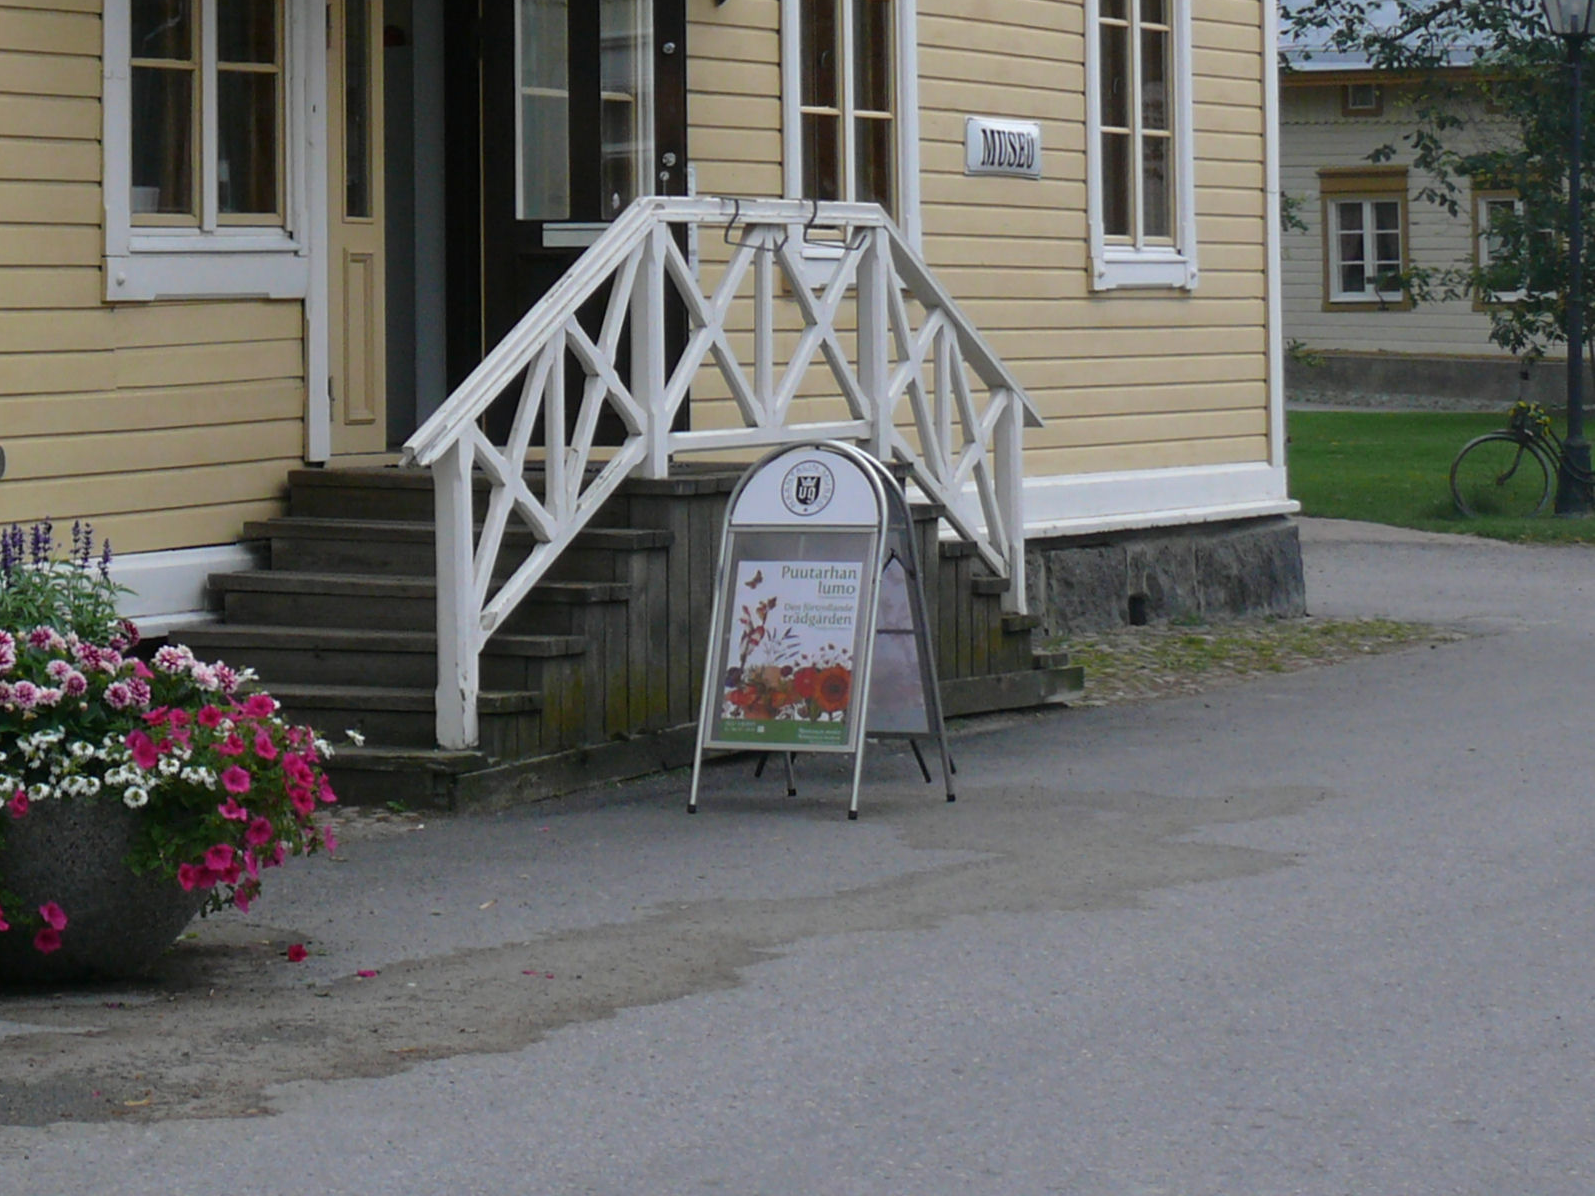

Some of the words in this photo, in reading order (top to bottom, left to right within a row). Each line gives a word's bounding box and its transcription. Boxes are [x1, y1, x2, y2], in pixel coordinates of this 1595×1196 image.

[980, 128, 1035, 169] MUSEO
[781, 565, 857, 580] Puutarhan
[817, 580, 856, 595] lumo
